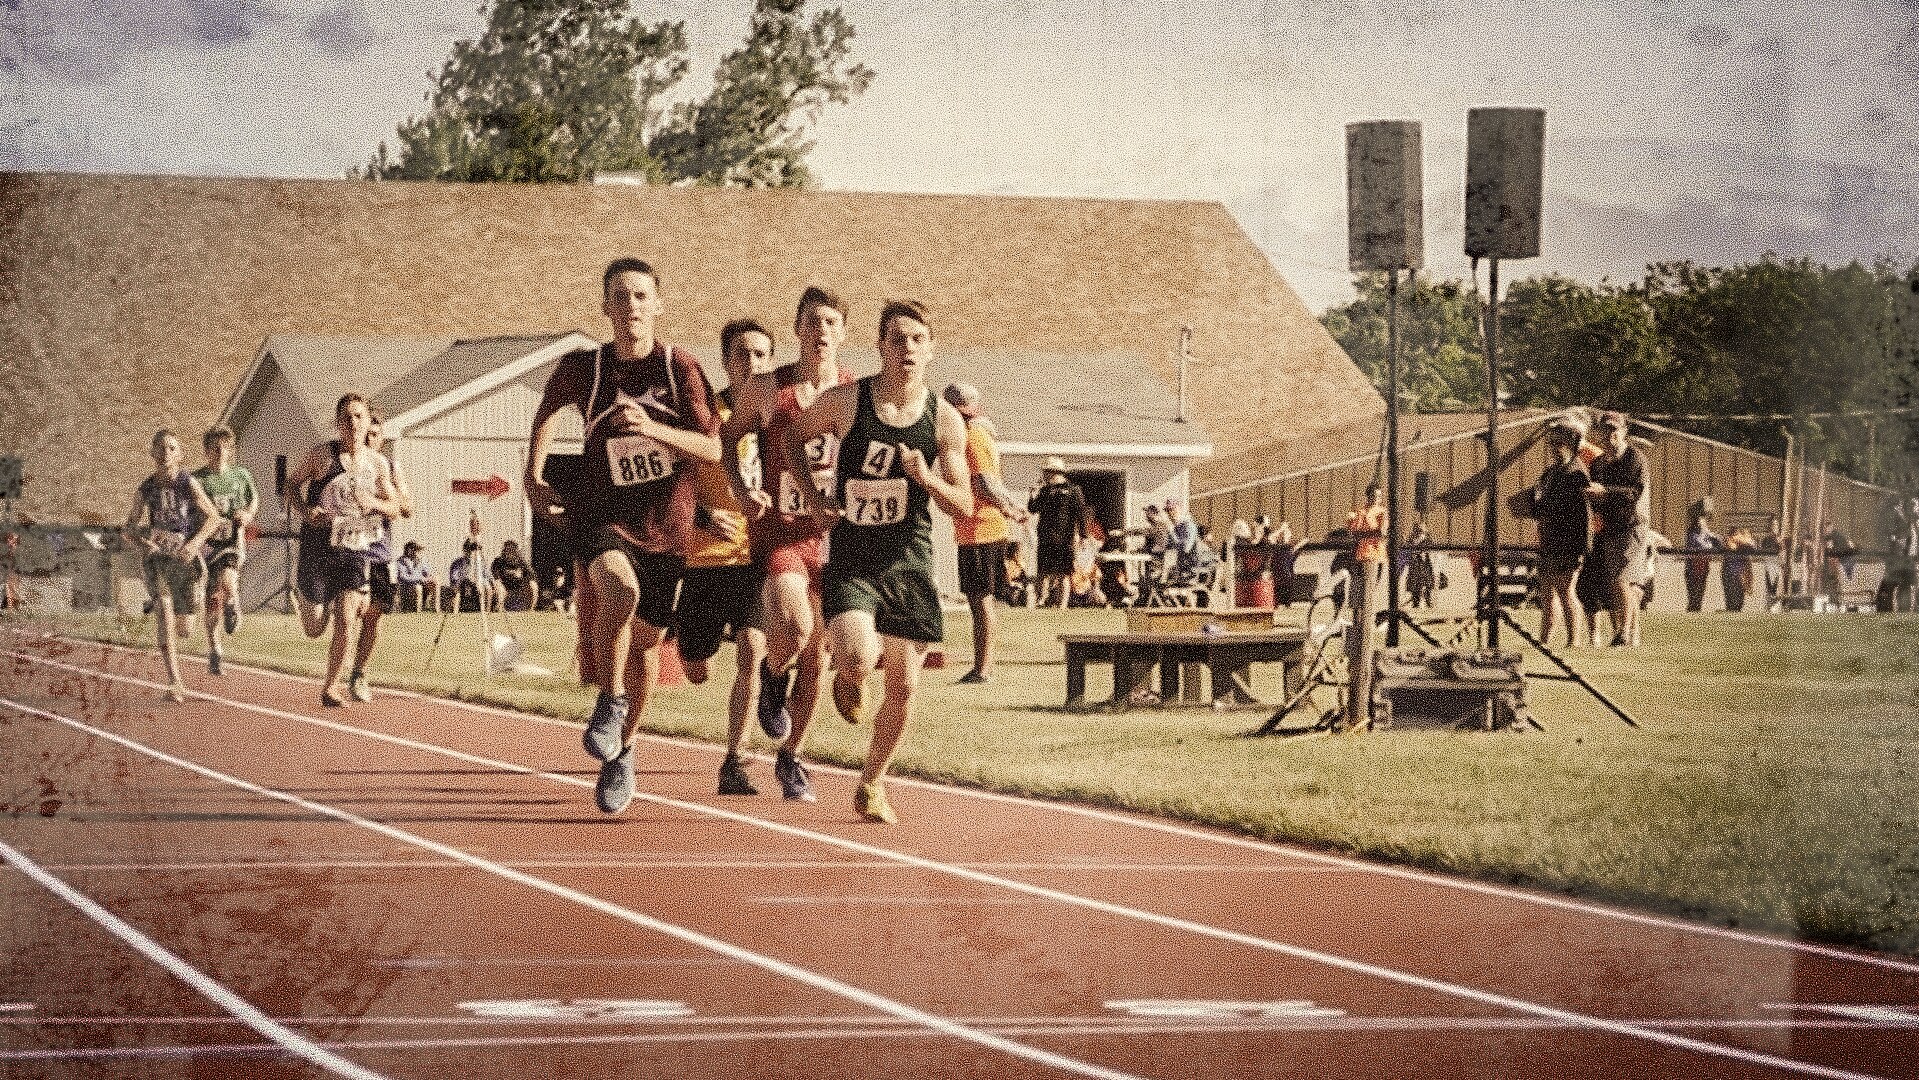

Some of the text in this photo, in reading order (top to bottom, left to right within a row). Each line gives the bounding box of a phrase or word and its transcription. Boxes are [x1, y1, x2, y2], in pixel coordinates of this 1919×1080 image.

[619, 450, 663, 481] 886
[867, 447, 888, 473] 4
[855, 497, 898, 522] 739
